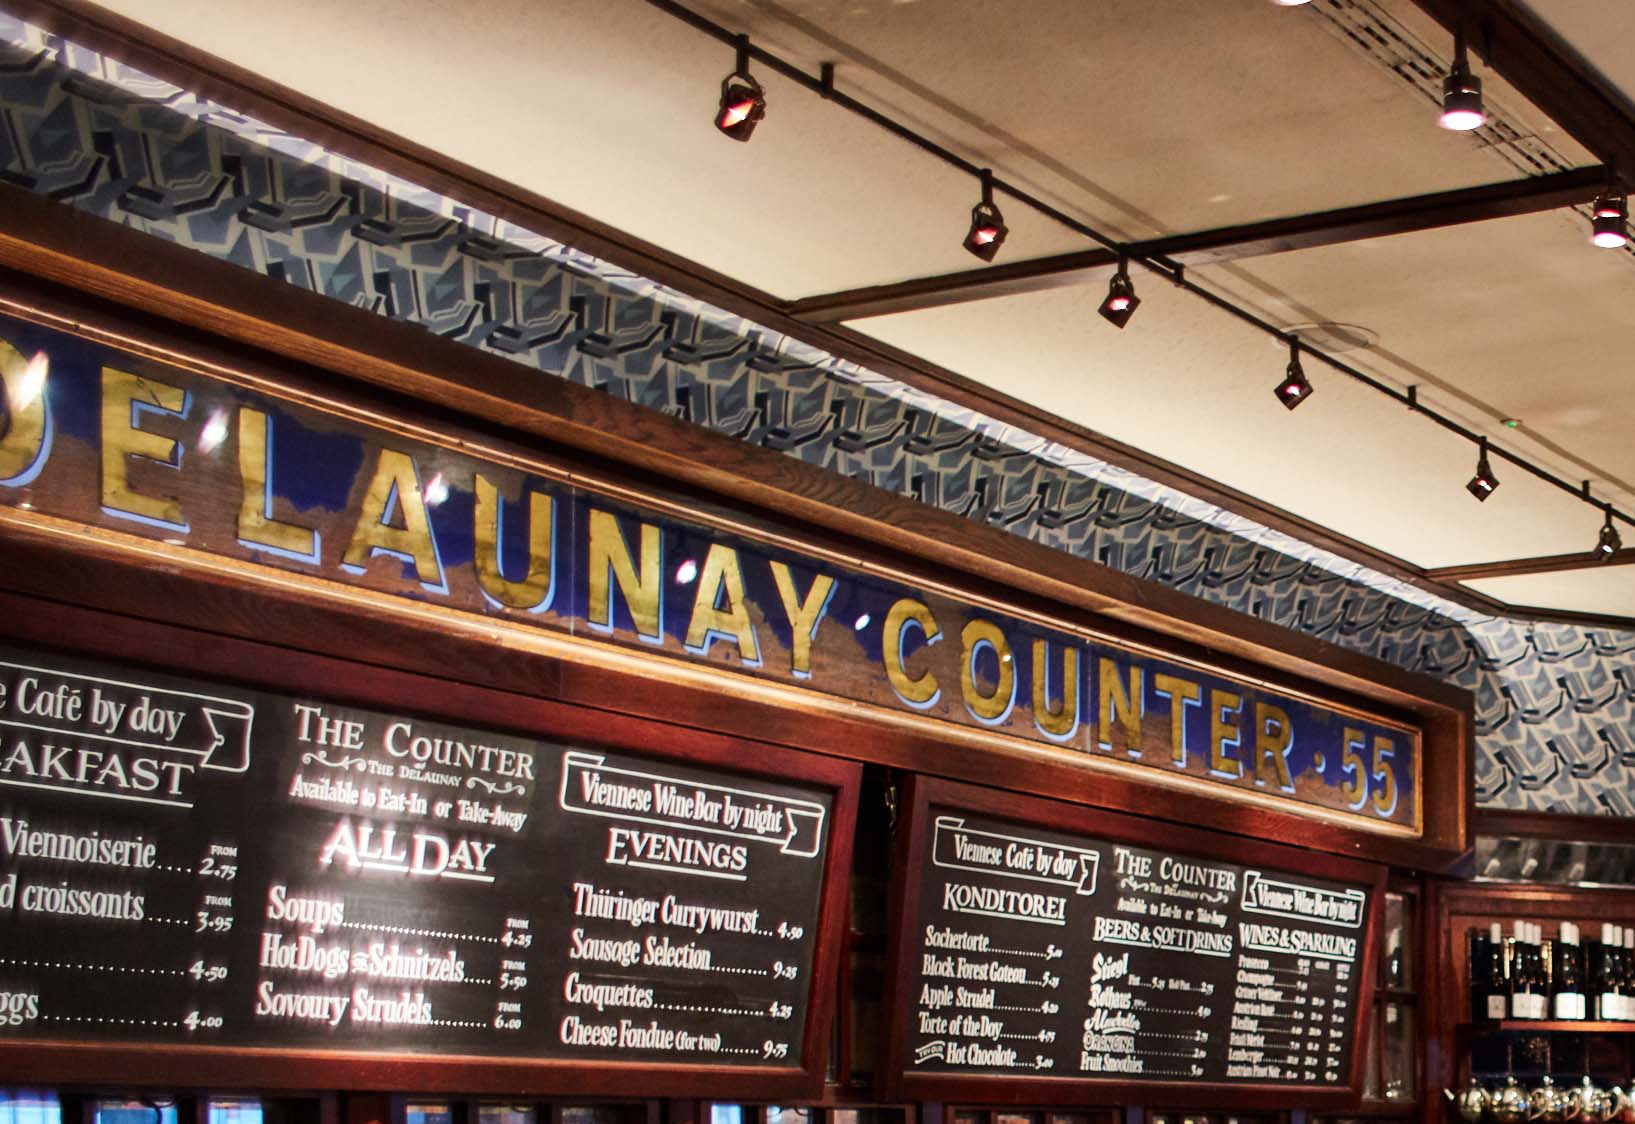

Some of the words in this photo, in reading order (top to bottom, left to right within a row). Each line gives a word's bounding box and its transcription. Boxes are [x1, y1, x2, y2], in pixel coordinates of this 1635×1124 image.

[17, 678, 82, 721] Café
[92, 689, 127, 733] by
[129, 697, 186, 741] day
[883, 598, 1296, 795] COUNTER
[1340, 725, 1398, 818] 55
[294, 704, 365, 750] THE
[384, 723, 535, 780] COUNTER
[0, 739, 195, 795] AKFAST
[368, 760, 394, 776] THE
[400, 765, 462, 787] DELAUNAY
[289, 774, 359, 807] Available
[360, 790, 377, 808] to
[378, 788, 428, 815] Eat-In
[435, 801, 453, 818] or
[458, 800, 527, 833] Take-Away
[581, 771, 651, 812] Viennese
[724, 795, 742, 830] by
[742, 805, 783, 834] night
[0, 817, 156, 868] Viennoiserie
[210, 845, 237, 857] FROM
[319, 822, 407, 867] ALL
[410, 833, 496, 875] DAY
[605, 828, 747, 871] EVENINGS
[955, 834, 1002, 865] Viennese
[1006, 843, 1034, 870] Café
[1036, 847, 1053, 876] by
[1053, 851, 1077, 880] day
[198, 858, 237, 880] 2.75
[1114, 848, 1152, 878] THE
[1160, 857, 1236, 892] COUNTER
[22, 881, 145, 921] croissants
[195, 911, 233, 933] 3.95
[205, 895, 232, 907] FROM
[268, 885, 344, 933] Soups
[573, 882, 659, 927] Thüringer
[662, 895, 759, 934] Currywurst
[943, 883, 1067, 920] KONDITOREI
[570, 928, 640, 967] Sausage
[643, 935, 711, 970] Selection
[925, 924, 989, 953] Sachertorte
[1092, 917, 1140, 942] BEERS
[1140, 927, 1151, 942] &
[1152, 926, 1186, 948] SOFT
[1186, 929, 1233, 953] DRINKS
[1239, 922, 1280, 947] WINES
[1290, 930, 1356, 957] SPARKLING
[189, 960, 228, 982] 4.50
[369, 943, 464, 983] Schnitzels
[922, 954, 955, 978] Black
[957, 957, 989, 981] Forest
[990, 962, 1027, 984] Gateau
[0, 992, 39, 1026] ggs
[183, 1011, 223, 1031] 4.00
[257, 981, 349, 1025] Savoury
[352, 988, 432, 1025] Strudels
[565, 972, 654, 1012] Croquettes
[920, 983, 953, 1009] Apple
[956, 986, 995, 1010] Strudel
[560, 1015, 618, 1048] Cheese
[619, 1019, 674, 1050] Fondue
[919, 1011, 947, 1034] Torte
[950, 1015, 963, 1036] of
[963, 1015, 981, 1036] the
[980, 1016, 1003, 1041] Day
[946, 1042, 966, 1064] Hot
[967, 1043, 1017, 1066] Chocolate
